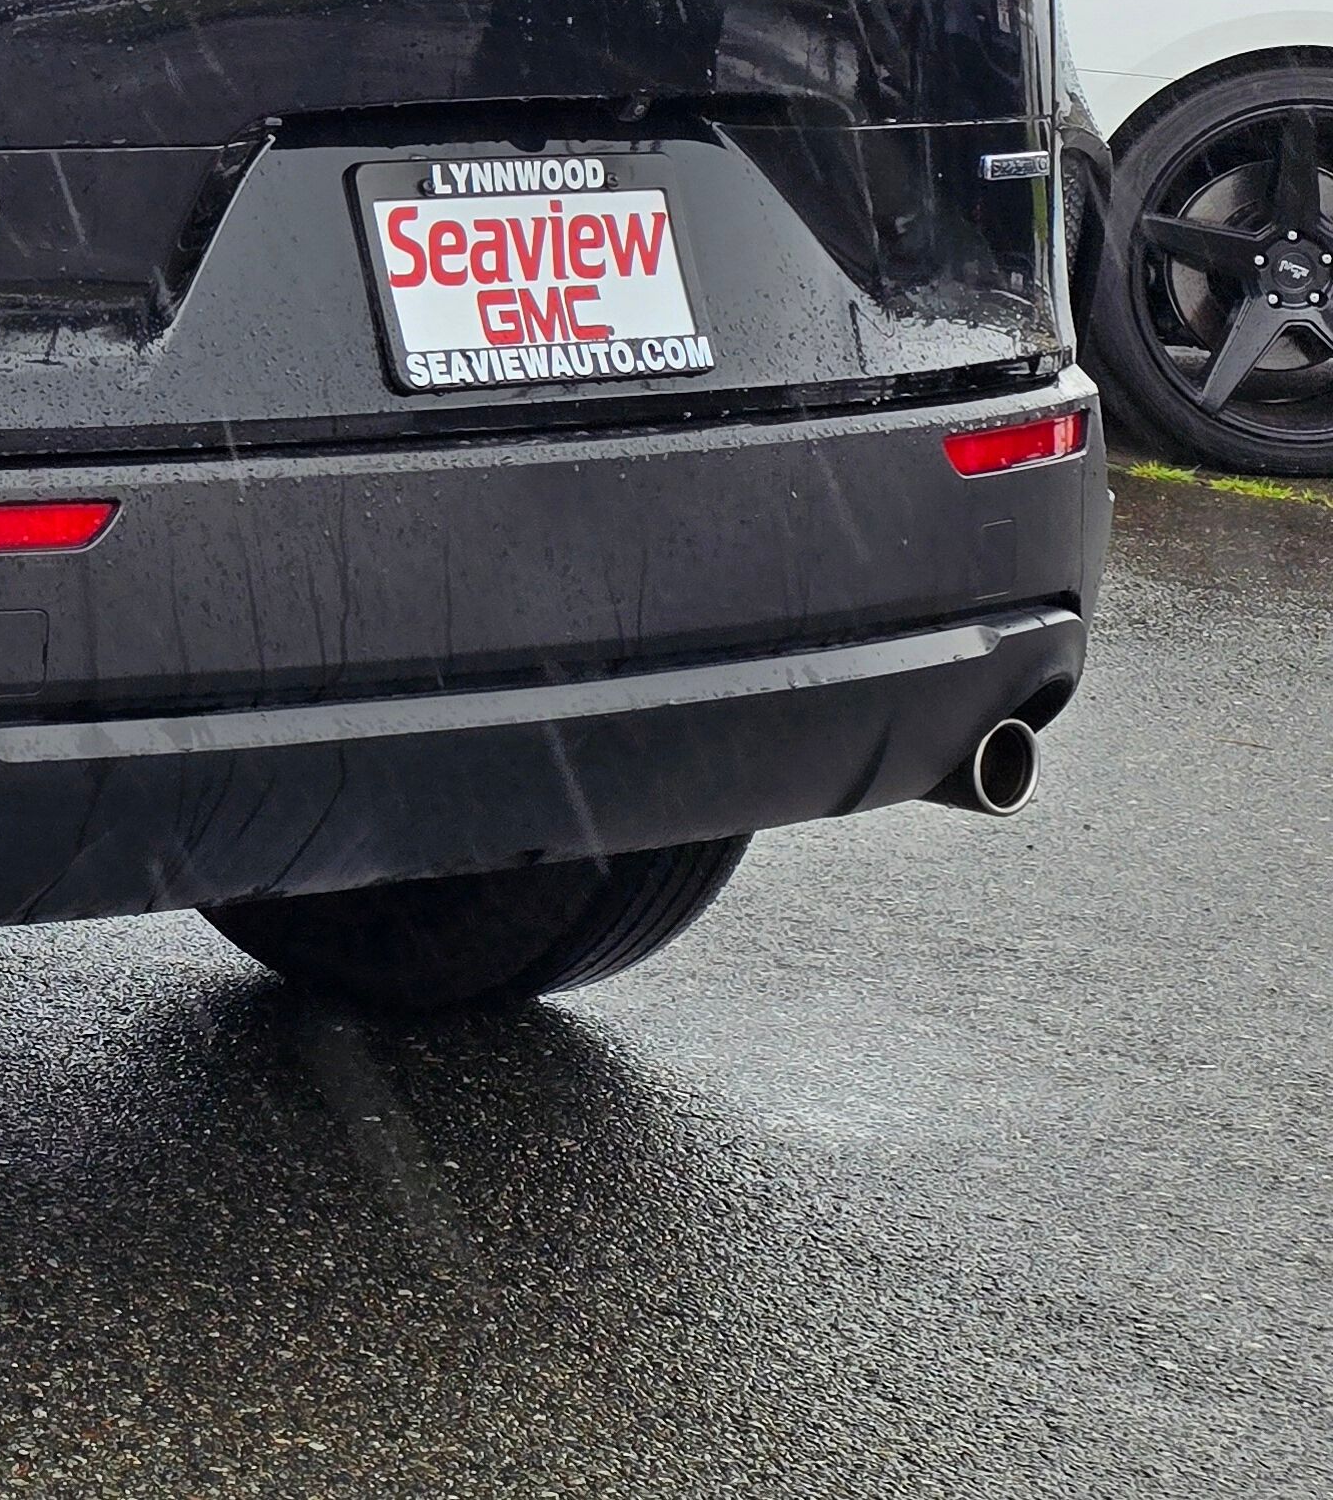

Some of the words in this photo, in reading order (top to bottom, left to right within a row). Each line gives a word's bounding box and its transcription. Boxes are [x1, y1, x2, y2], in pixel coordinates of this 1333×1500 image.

[431, 158, 605, 195] LYNNWOOD
[387, 199, 668, 288] Seaview
[477, 284, 615, 346] GMC
[406, 336, 715, 388] SEAVIEWAUTO.COM
